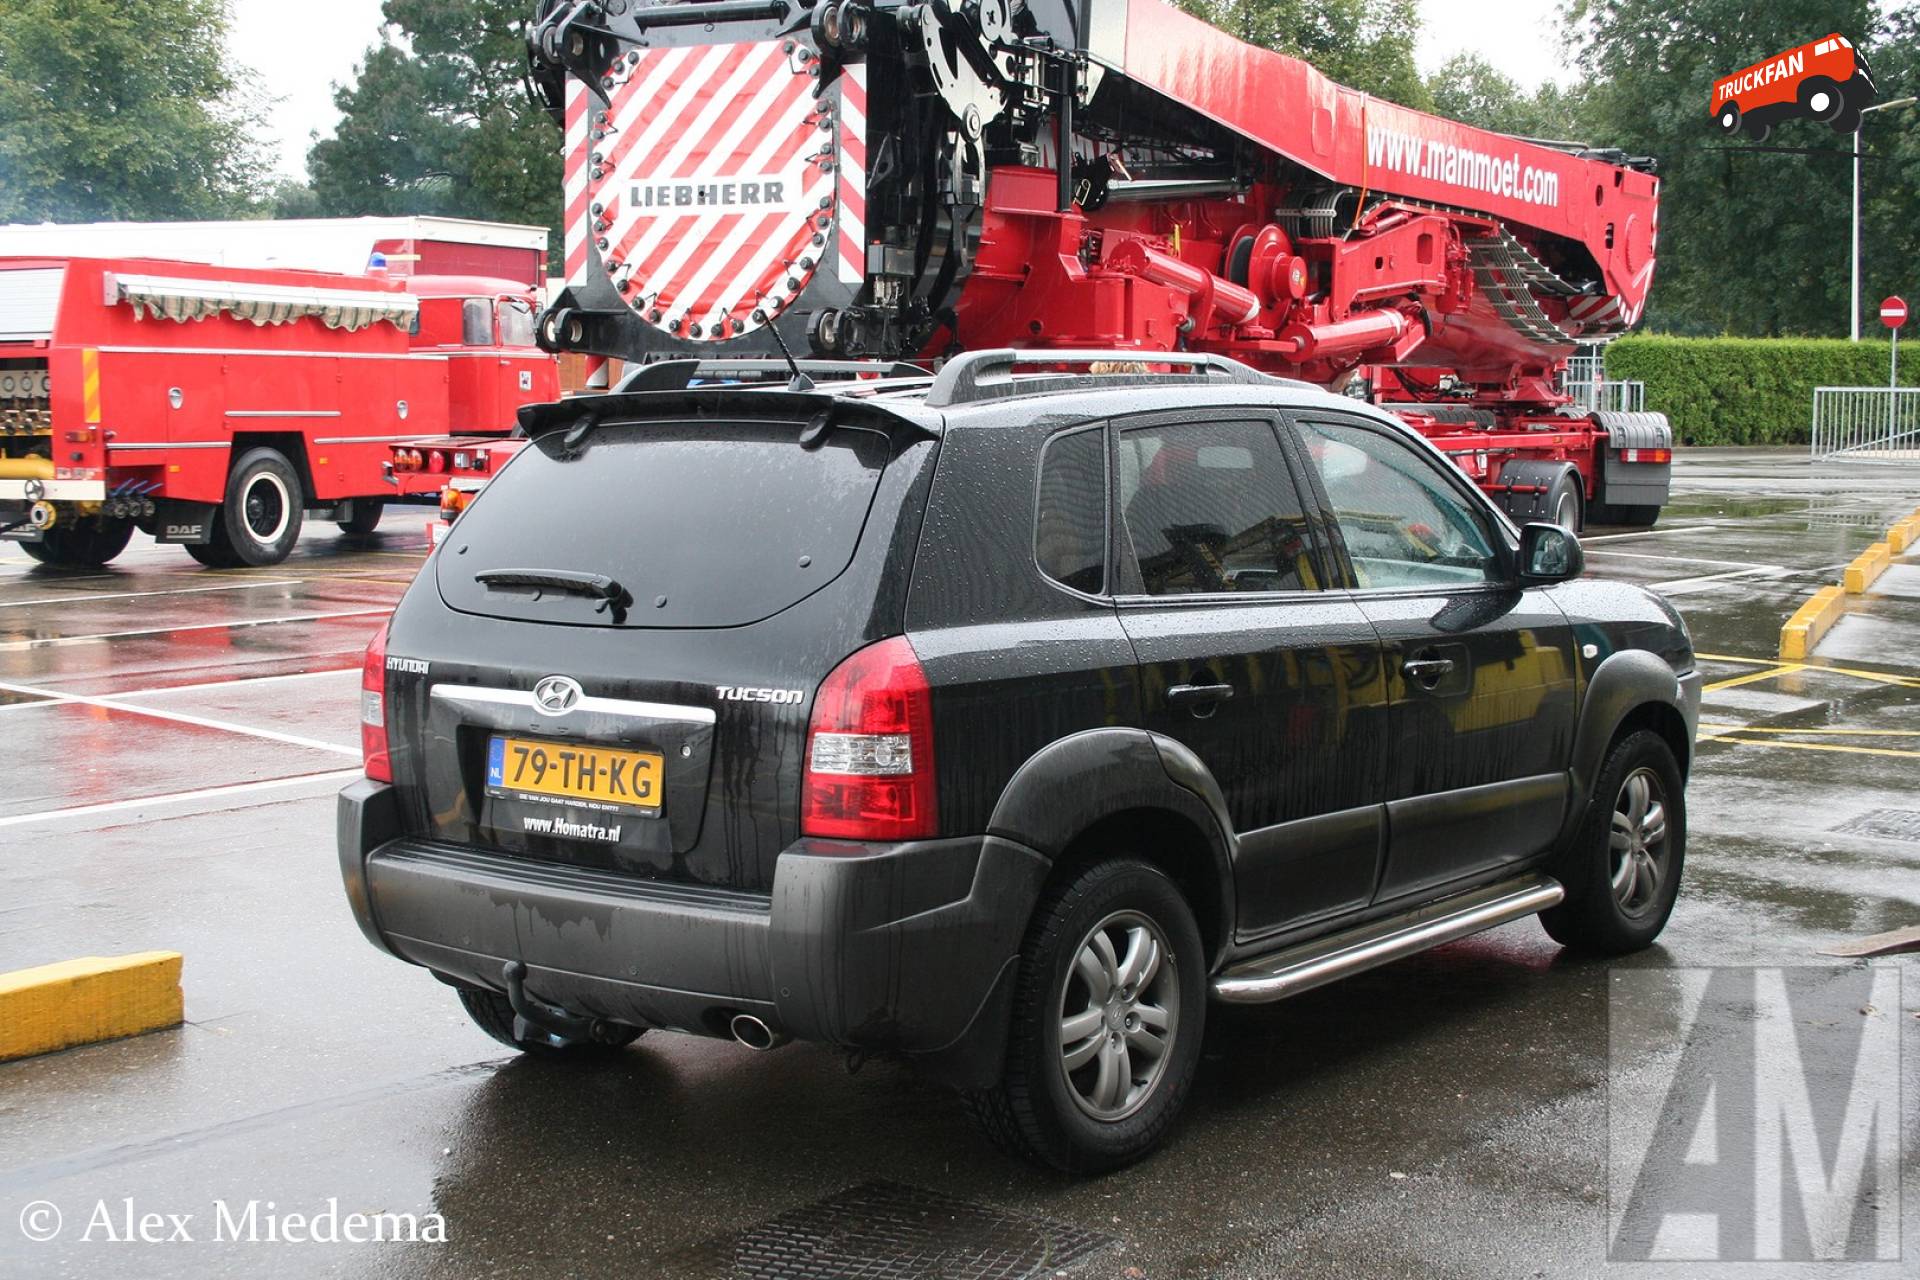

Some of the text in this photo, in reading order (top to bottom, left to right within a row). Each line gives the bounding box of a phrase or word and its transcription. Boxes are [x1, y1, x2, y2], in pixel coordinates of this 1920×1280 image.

[1367, 127, 1558, 207] www.mammoet.com
[631, 182, 784, 207] LIEBHERR
[166, 525, 202, 534] DAF
[386, 656, 430, 674] HYUNDAI
[716, 686, 804, 704] TUCSON
[490, 767, 501, 778] NL
[514, 747, 651, 798] 79-TH-KG
[523, 817, 622, 842] www.Homatra.nl
